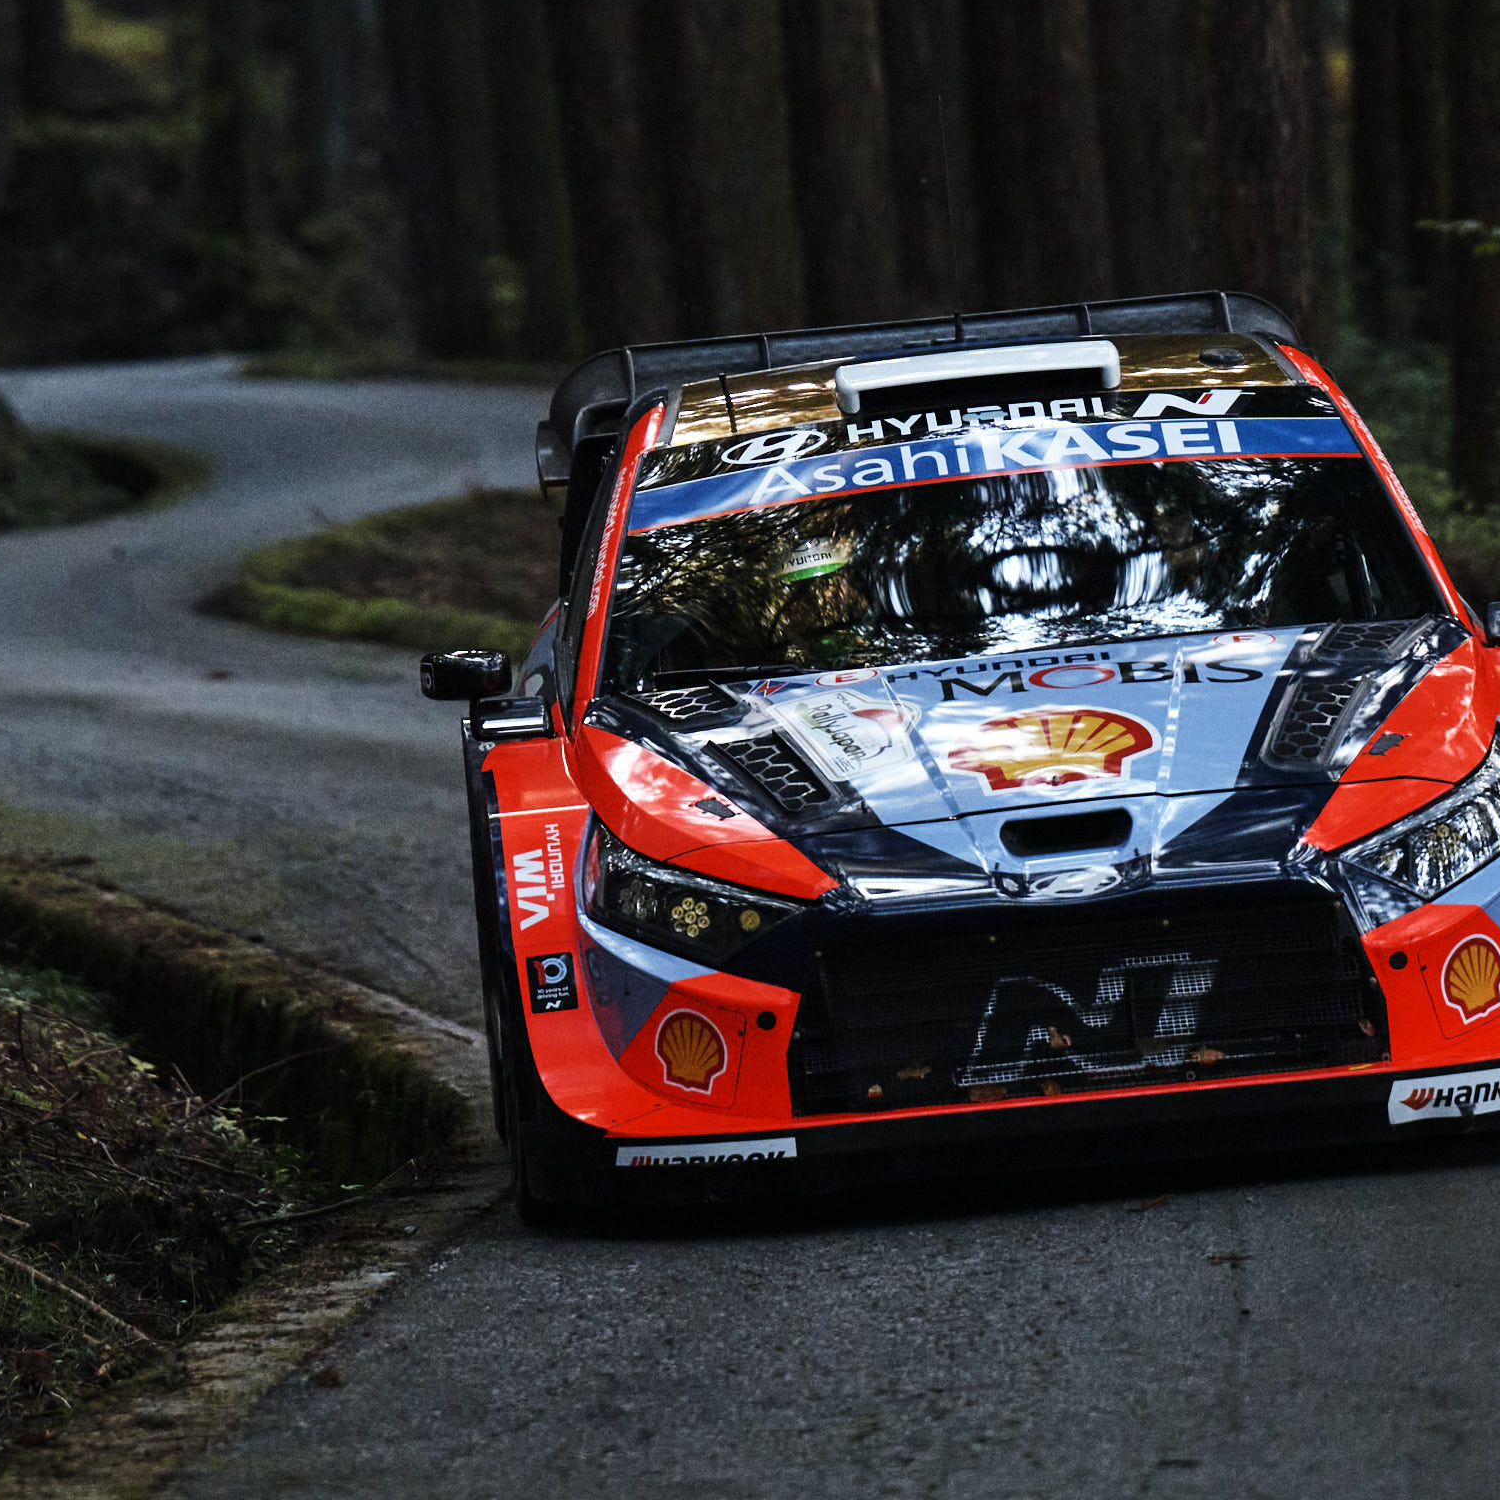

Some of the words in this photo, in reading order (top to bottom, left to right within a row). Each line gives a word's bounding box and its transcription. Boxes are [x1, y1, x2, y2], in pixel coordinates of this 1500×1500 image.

[847, 397, 1105, 443] HYUNDAI
[887, 652, 1110, 684] HYUNDAI
[940, 659, 1264, 701] MOBIS
[545, 823, 565, 889] HYUNDAI
[513, 848, 555, 931] WIA
